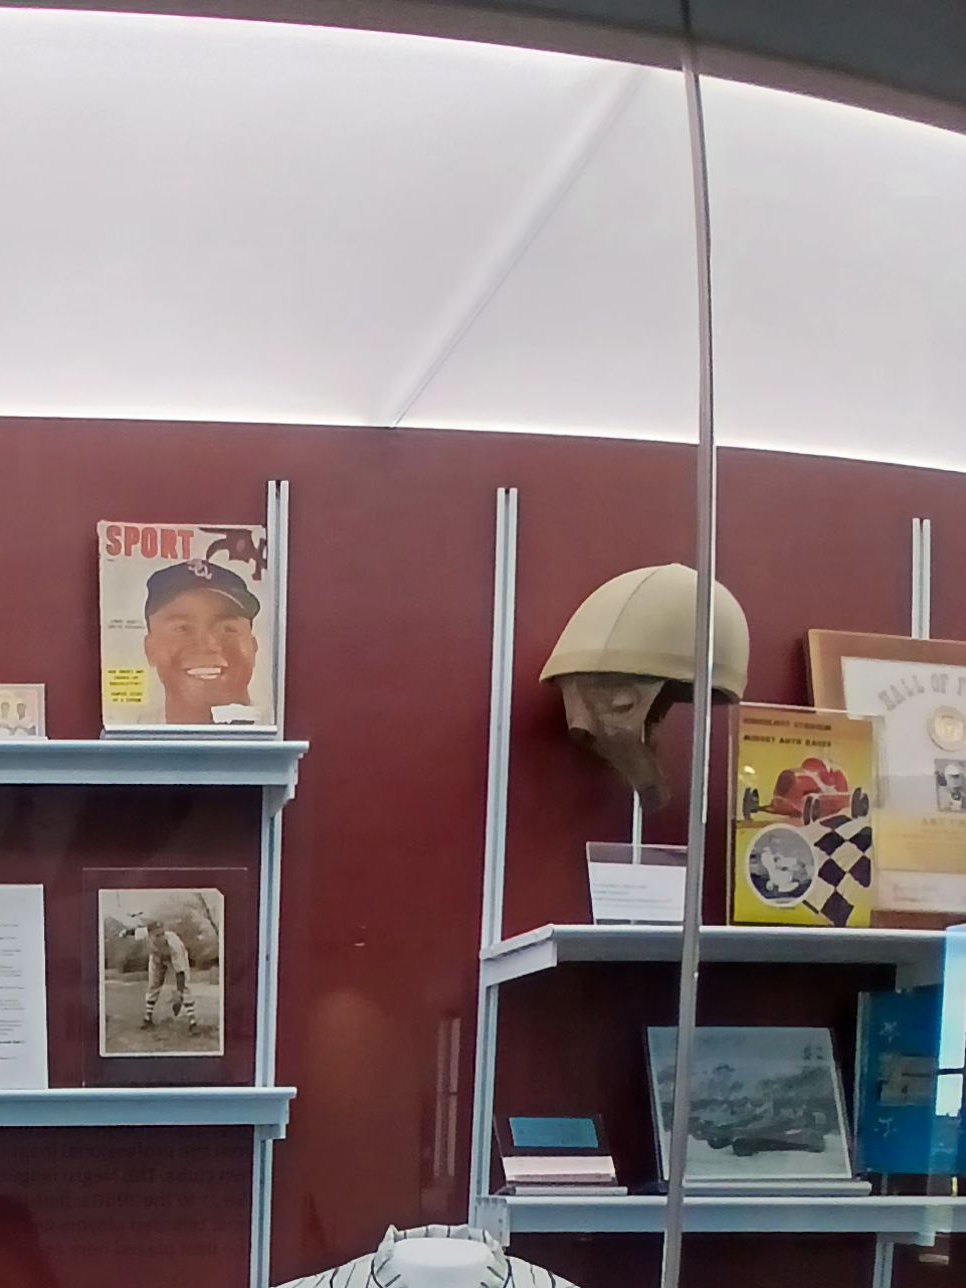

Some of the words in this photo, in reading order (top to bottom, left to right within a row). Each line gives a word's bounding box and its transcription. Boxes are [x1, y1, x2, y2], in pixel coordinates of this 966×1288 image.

[106, 524, 195, 560] SPORT
[878, 674, 926, 712] HALL
[931, 673, 949, 695] OF
